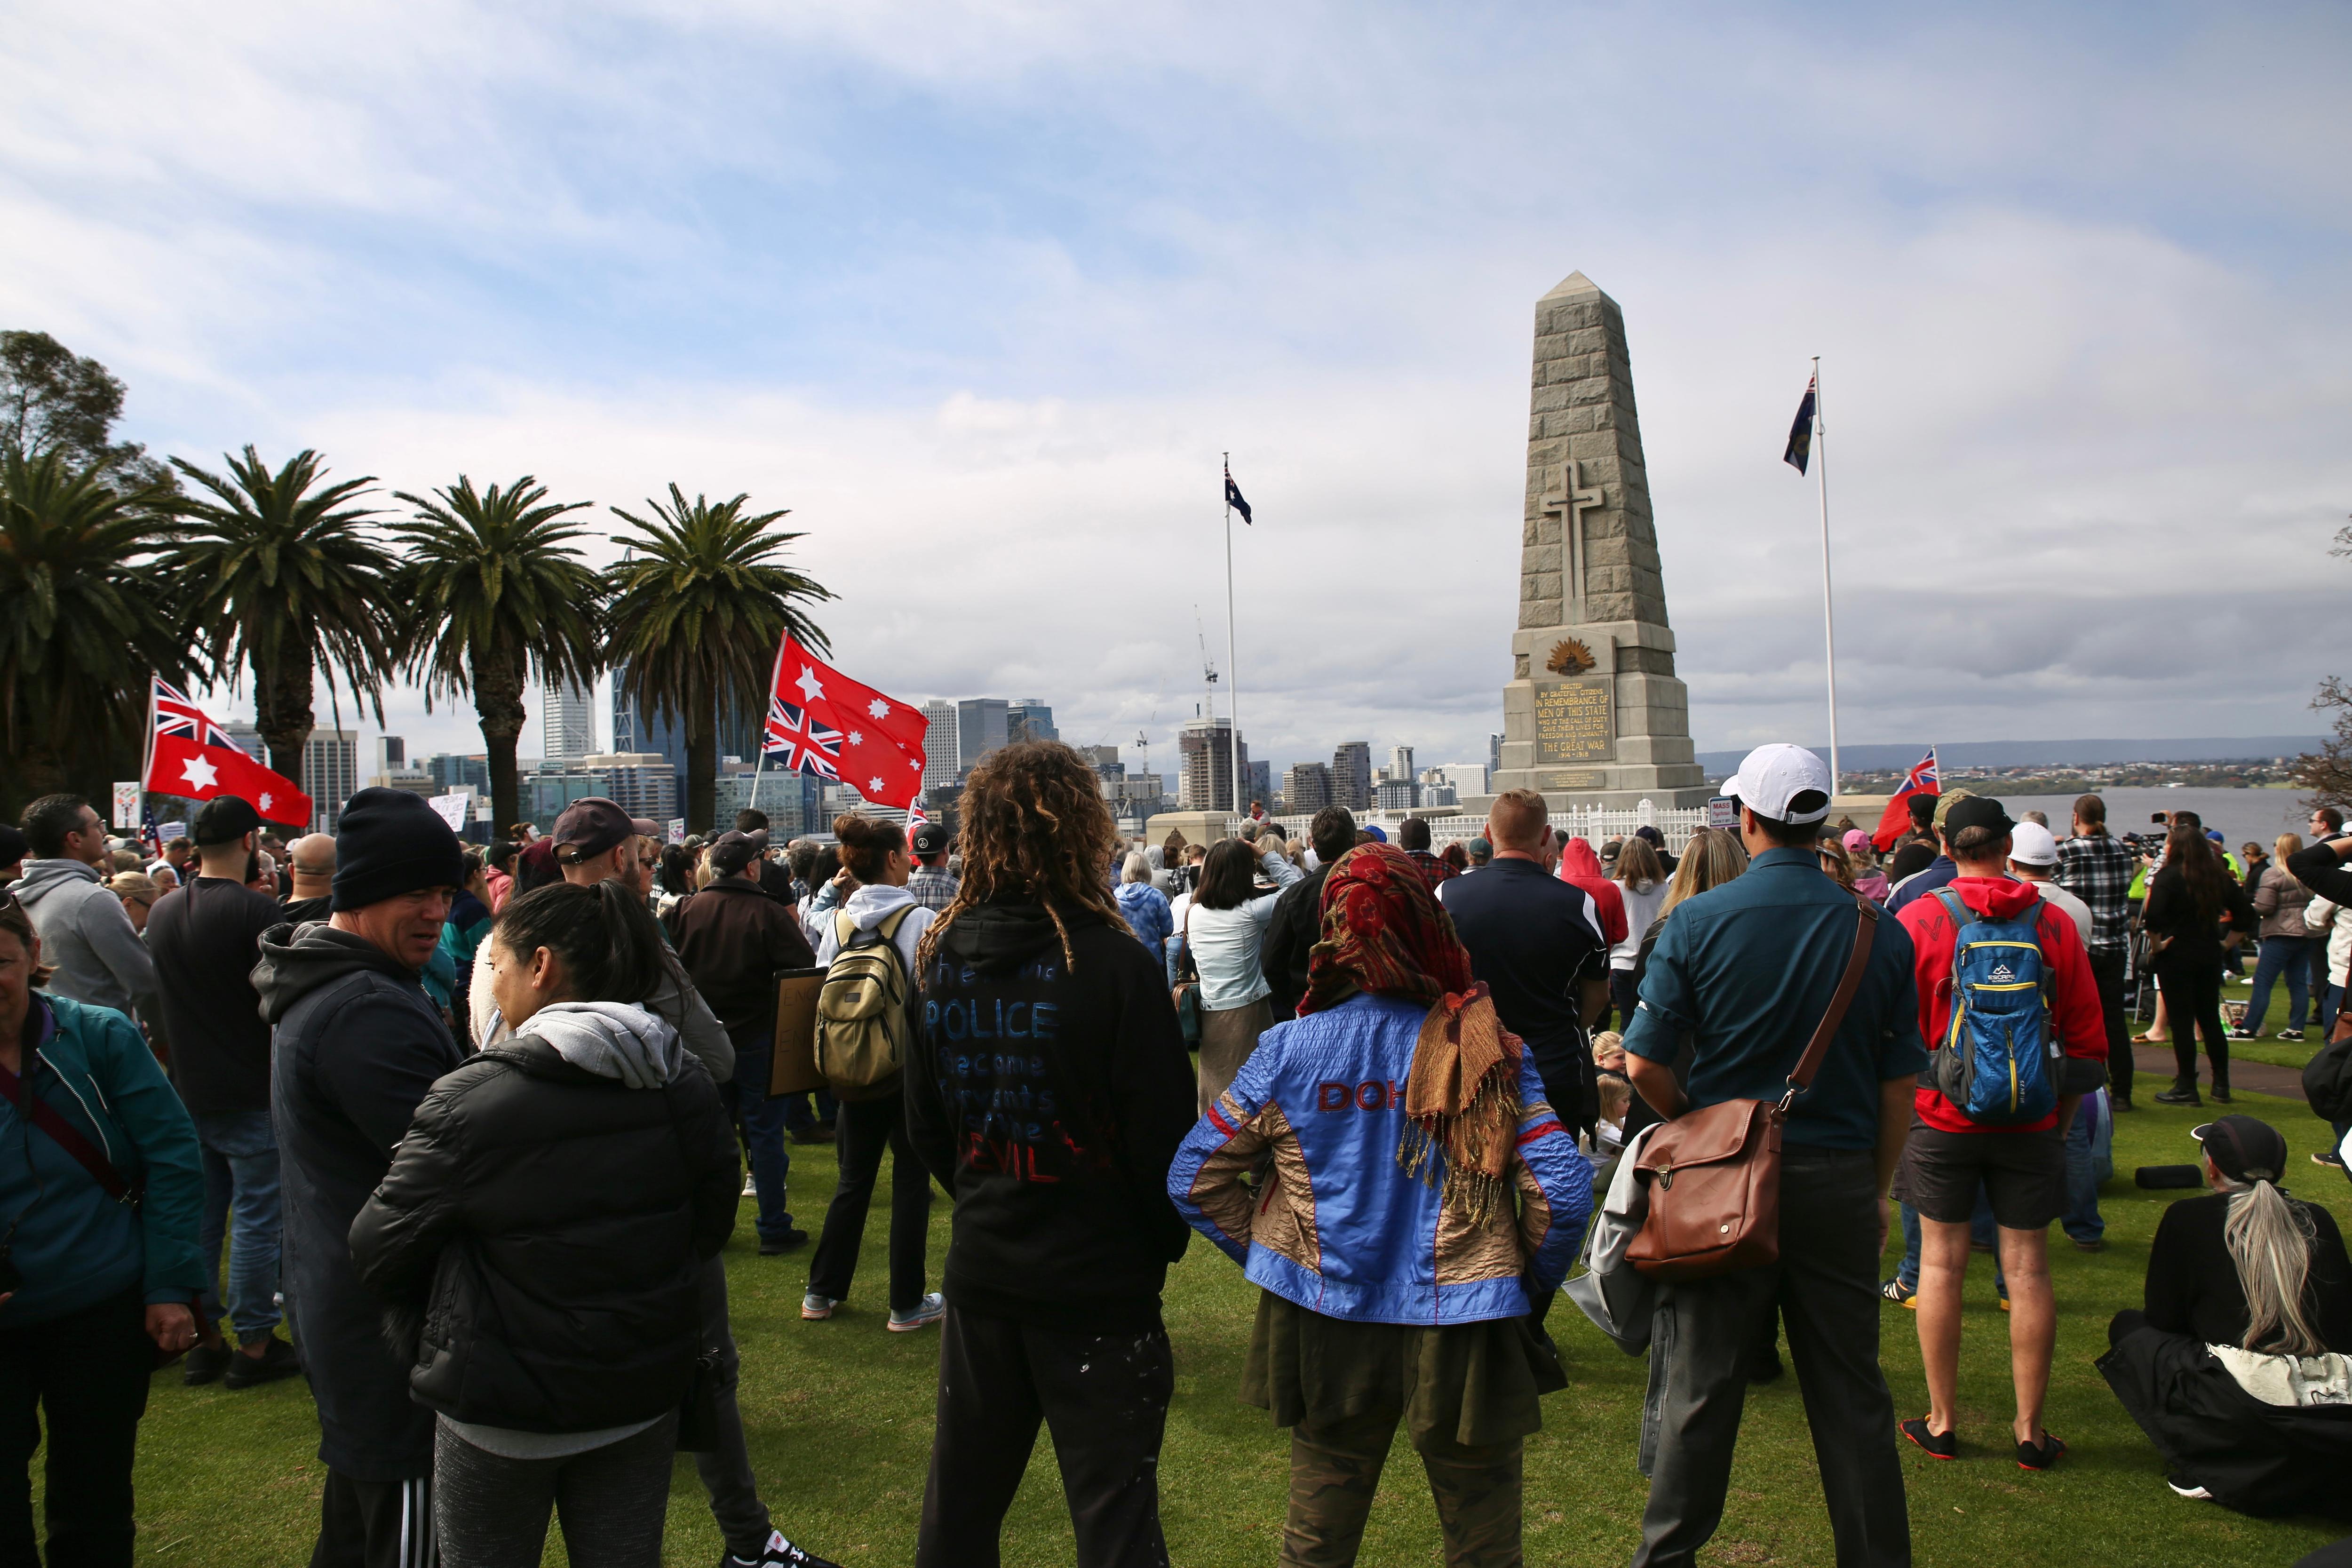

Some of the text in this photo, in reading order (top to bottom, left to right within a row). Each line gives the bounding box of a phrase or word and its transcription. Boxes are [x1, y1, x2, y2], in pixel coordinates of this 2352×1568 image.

[1545, 696, 1597, 707] REMEMBRANCE
[1538, 706, 1607, 718] MEN OF THIS STATE
[1543, 740, 1605, 752] THE GREAT WAR
[925, 998, 1060, 1040] POLICE
